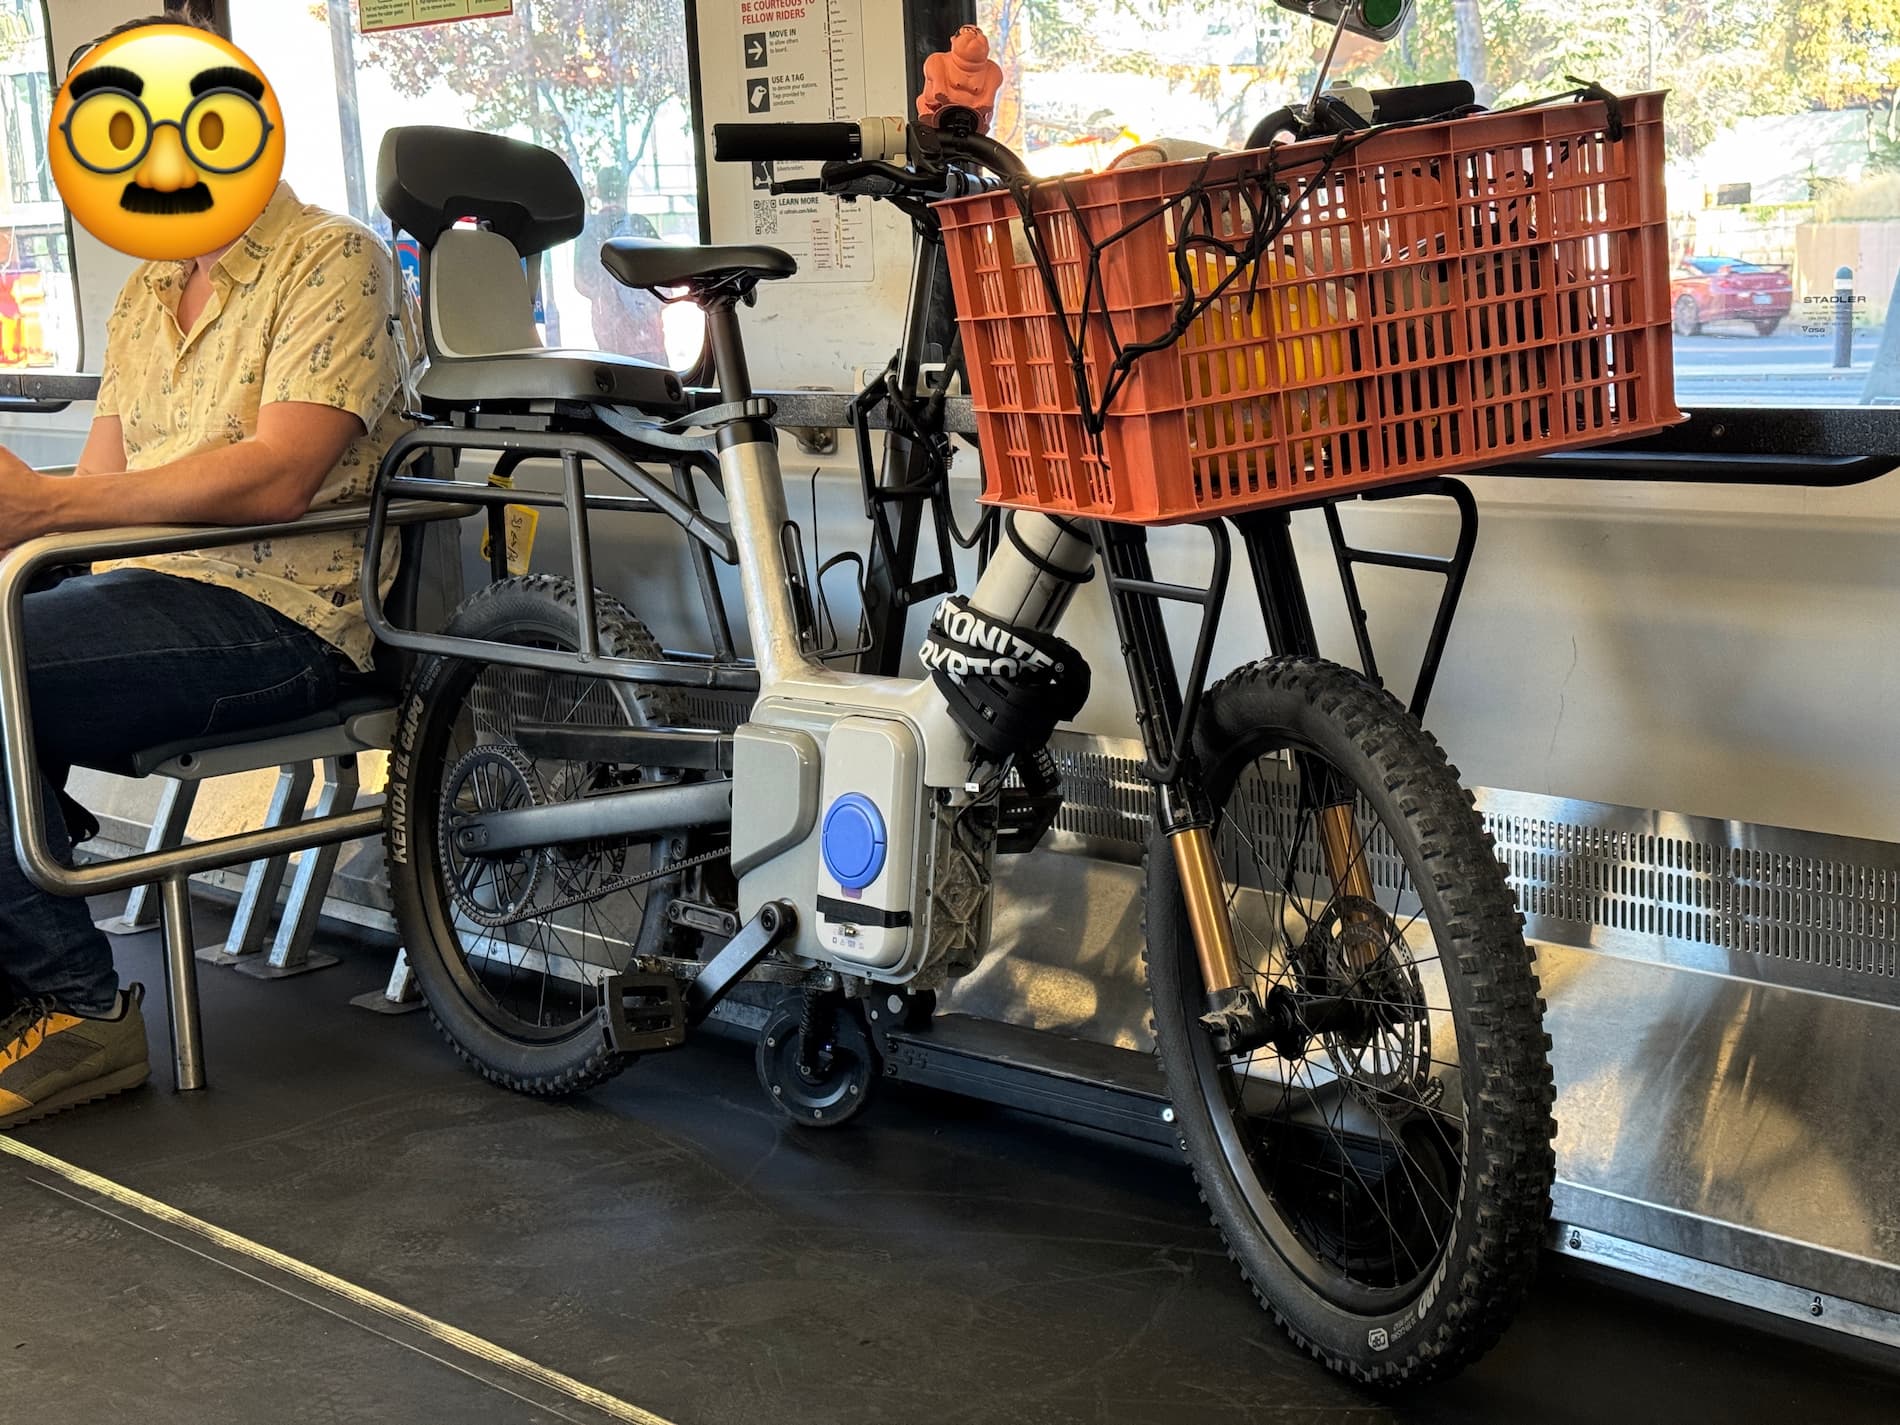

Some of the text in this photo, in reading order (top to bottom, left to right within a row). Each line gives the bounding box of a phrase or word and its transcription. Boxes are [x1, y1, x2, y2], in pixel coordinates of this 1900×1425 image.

[741, 3, 752, 13] BE
[753, 0, 802, 11] COURTEOUS
[742, 8, 806, 25] FELLOW RIDERS
[769, 28, 797, 38] MOVE IN
[771, 73, 805, 84] USE A TAG
[779, 196, 818, 206] LEARN MORE
[1803, 295, 1866, 304] STADLER
[392, 694, 425, 864] KENDA EL CAPO
